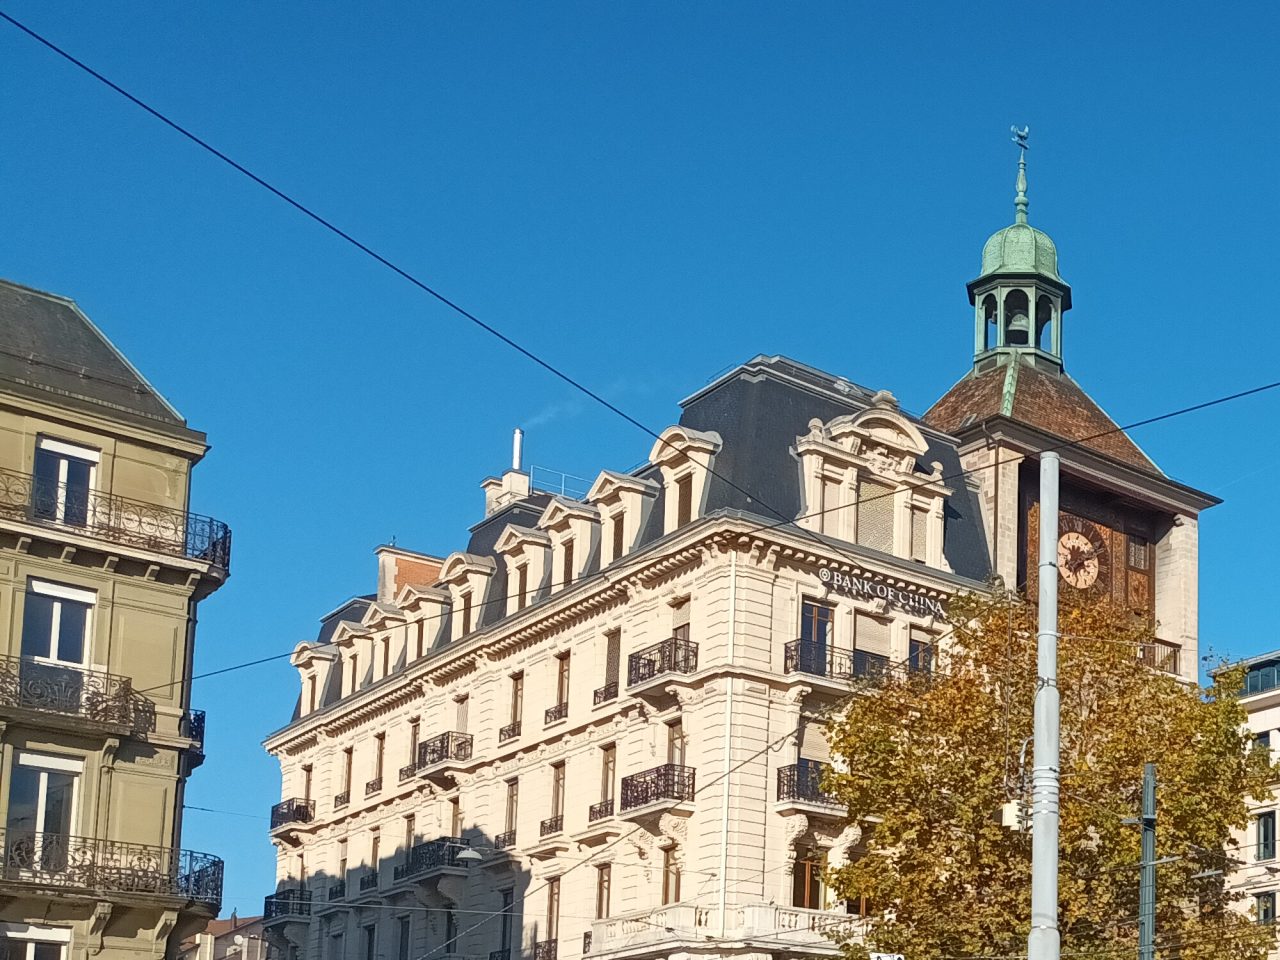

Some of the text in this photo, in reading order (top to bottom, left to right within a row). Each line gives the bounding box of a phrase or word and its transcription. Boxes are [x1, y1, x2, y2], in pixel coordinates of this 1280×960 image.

[833, 571, 948, 619] BANK OF CHINA
